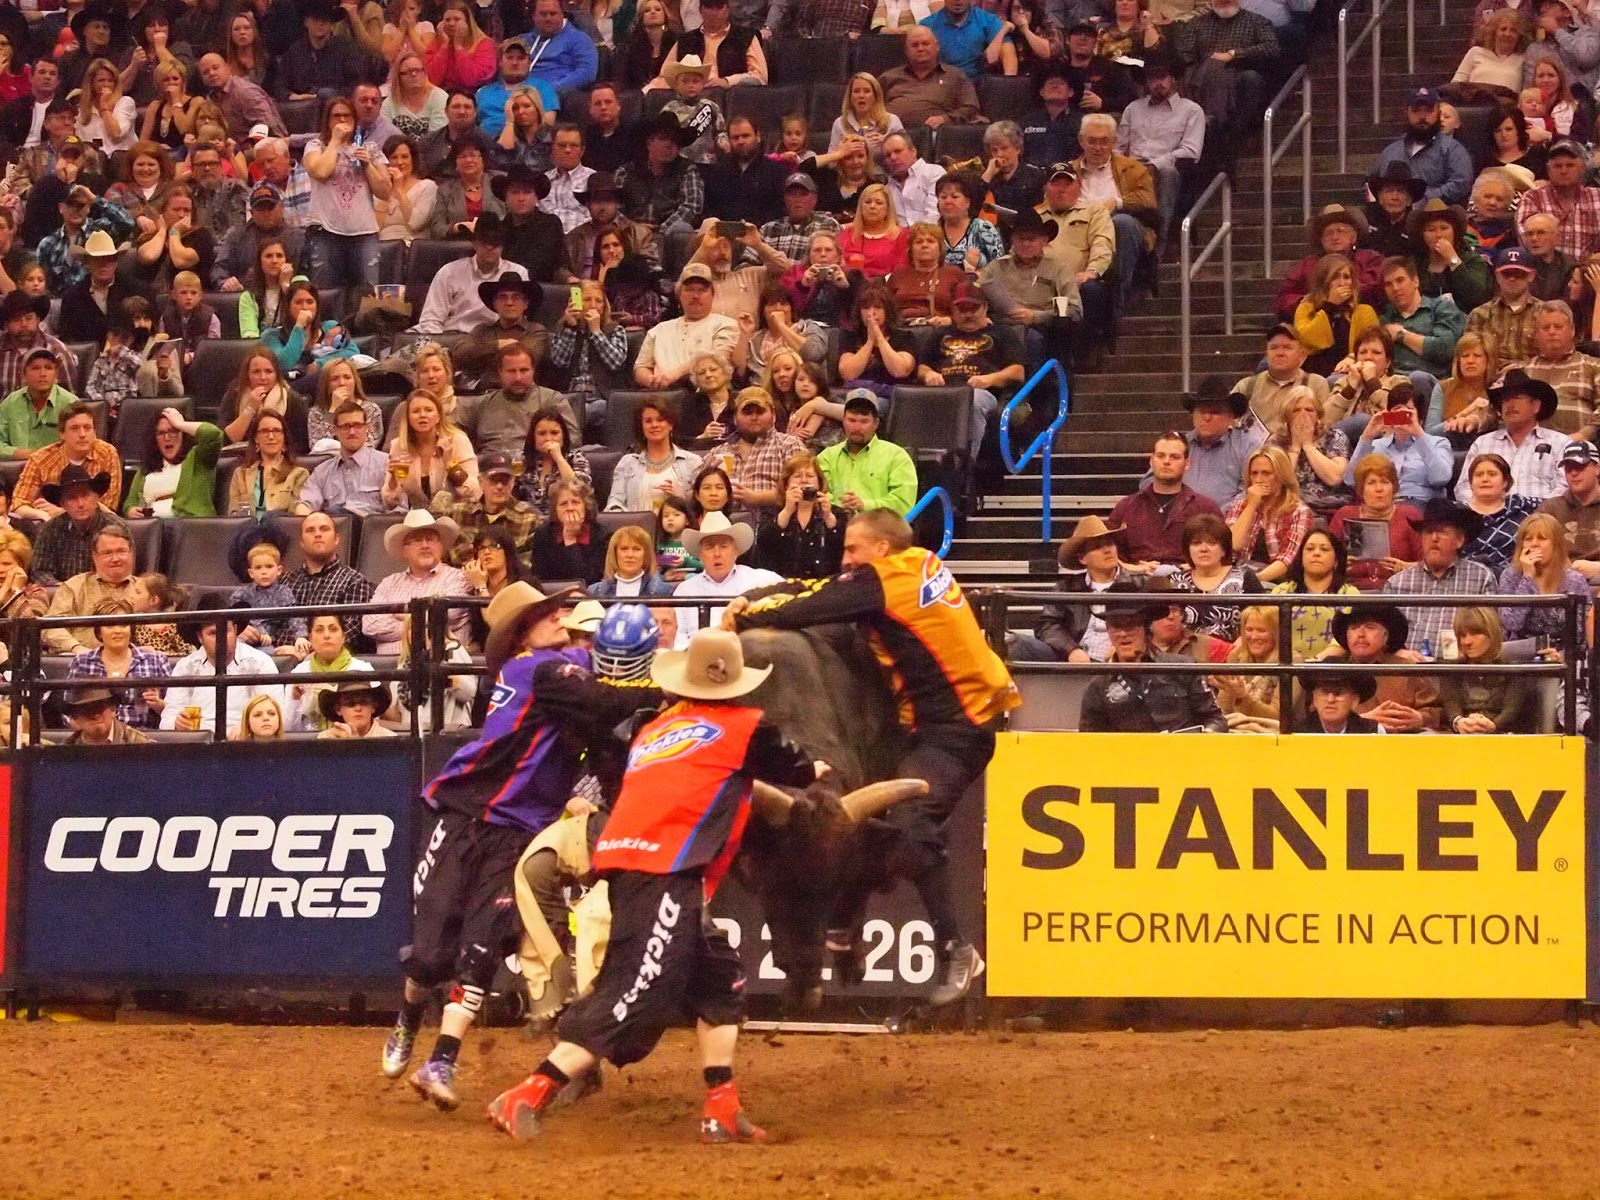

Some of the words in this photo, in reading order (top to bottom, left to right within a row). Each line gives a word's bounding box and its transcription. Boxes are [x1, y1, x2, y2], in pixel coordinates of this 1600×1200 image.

[1508, 251, 1520, 262] T
[44, 814, 394, 873] COOPER
[597, 837, 661, 852] Dickies
[1022, 785, 1567, 872] STANLEY
[209, 876, 386, 918] TIRES
[862, 919, 935, 983] 26
[1024, 912, 1319, 943] PERFORMANCE
[1338, 913, 1372, 943] IN
[1389, 914, 1539, 945] ACTION
[612, 892, 681, 1022] Dickies
